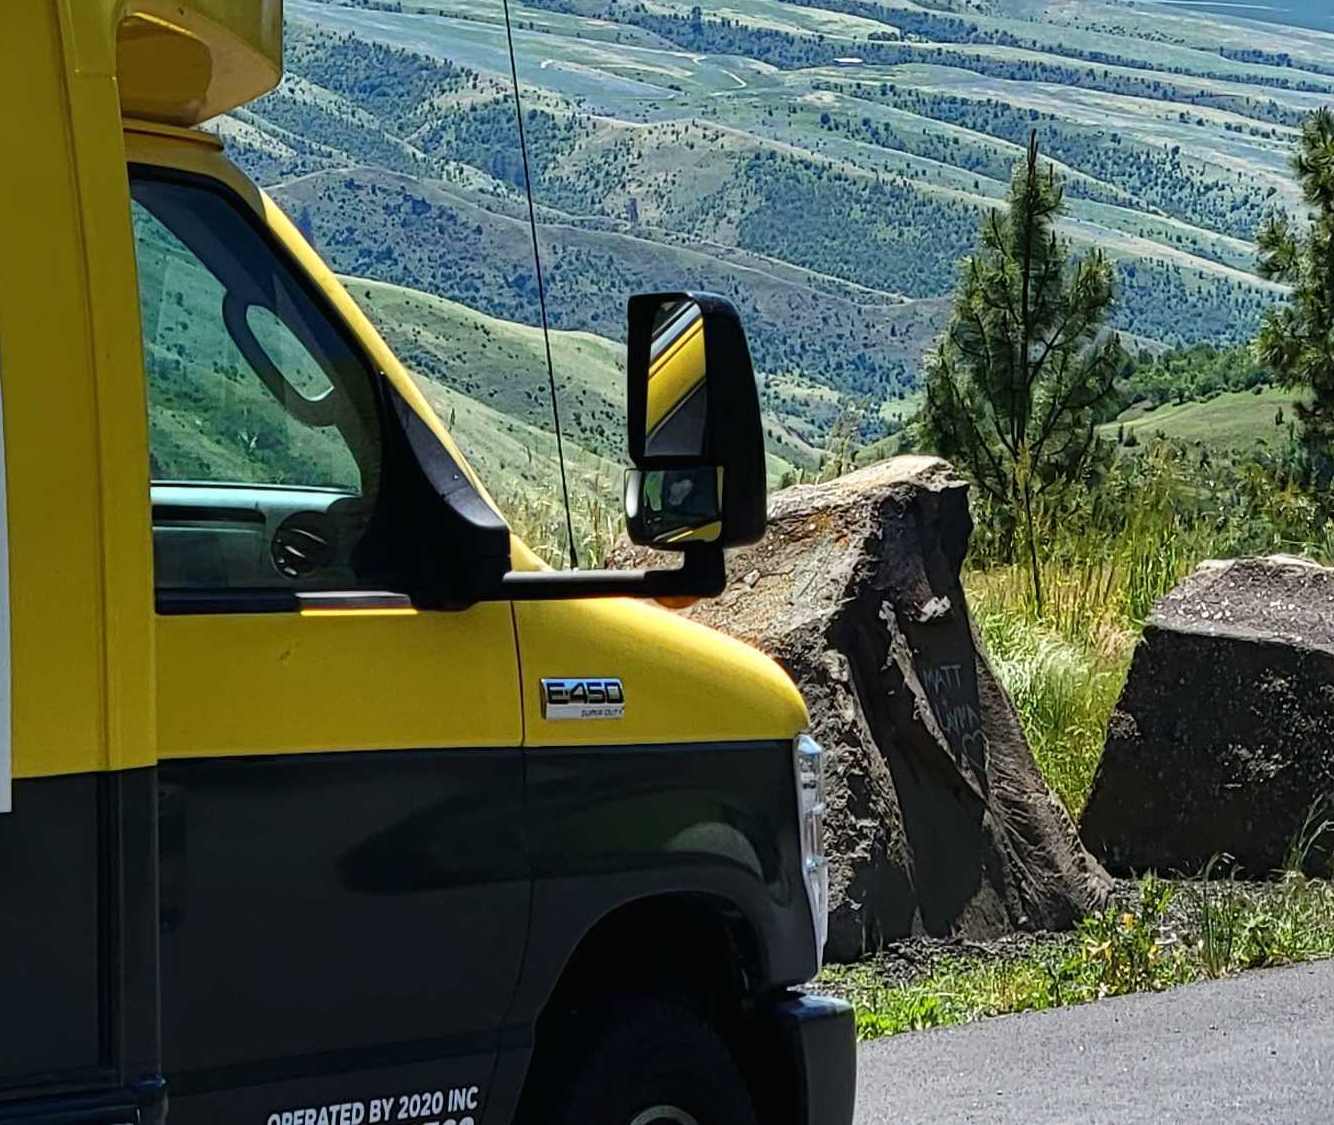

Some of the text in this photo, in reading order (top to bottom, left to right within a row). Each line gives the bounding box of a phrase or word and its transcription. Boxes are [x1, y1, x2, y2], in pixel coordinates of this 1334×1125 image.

[368, 1097, 395, 1123] BY
[397, 1091, 444, 1120] 2020
[447, 1086, 479, 1112] INC
